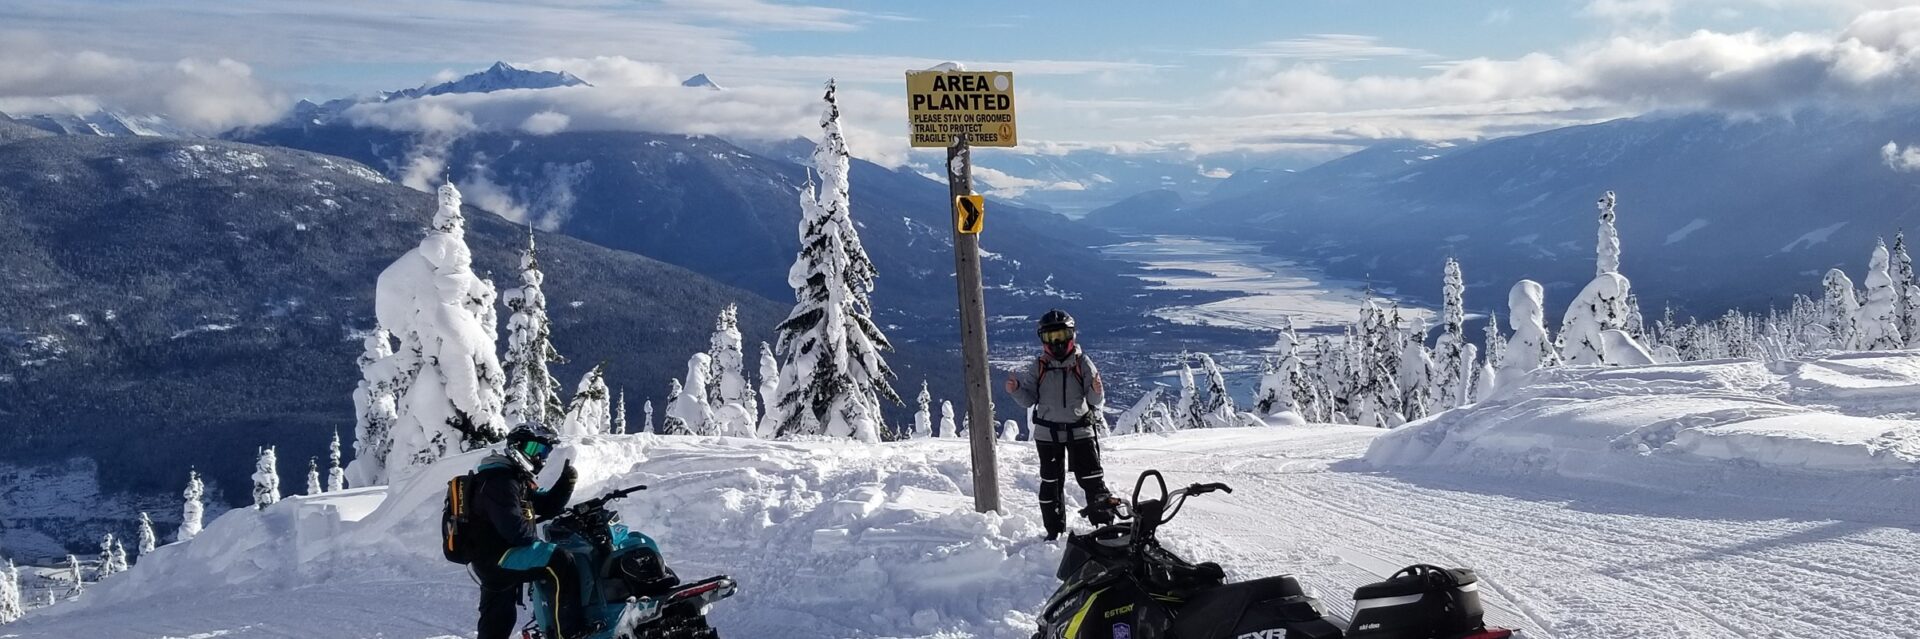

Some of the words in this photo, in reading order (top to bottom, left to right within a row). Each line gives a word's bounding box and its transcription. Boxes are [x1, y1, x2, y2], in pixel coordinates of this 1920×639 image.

[932, 75, 990, 92] AREA
[912, 94, 1010, 111] PLANTED
[914, 114, 942, 123] PLEASE
[943, 114, 962, 123] STAY
[963, 114, 975, 123] ON
[975, 114, 1012, 123] GROOMED
[914, 124, 937, 133] TRAIL
[938, 124, 949, 133] TO
[949, 124, 983, 133] PROTECT
[915, 133, 946, 143] FRAGILE
[975, 133, 998, 142] TREES
